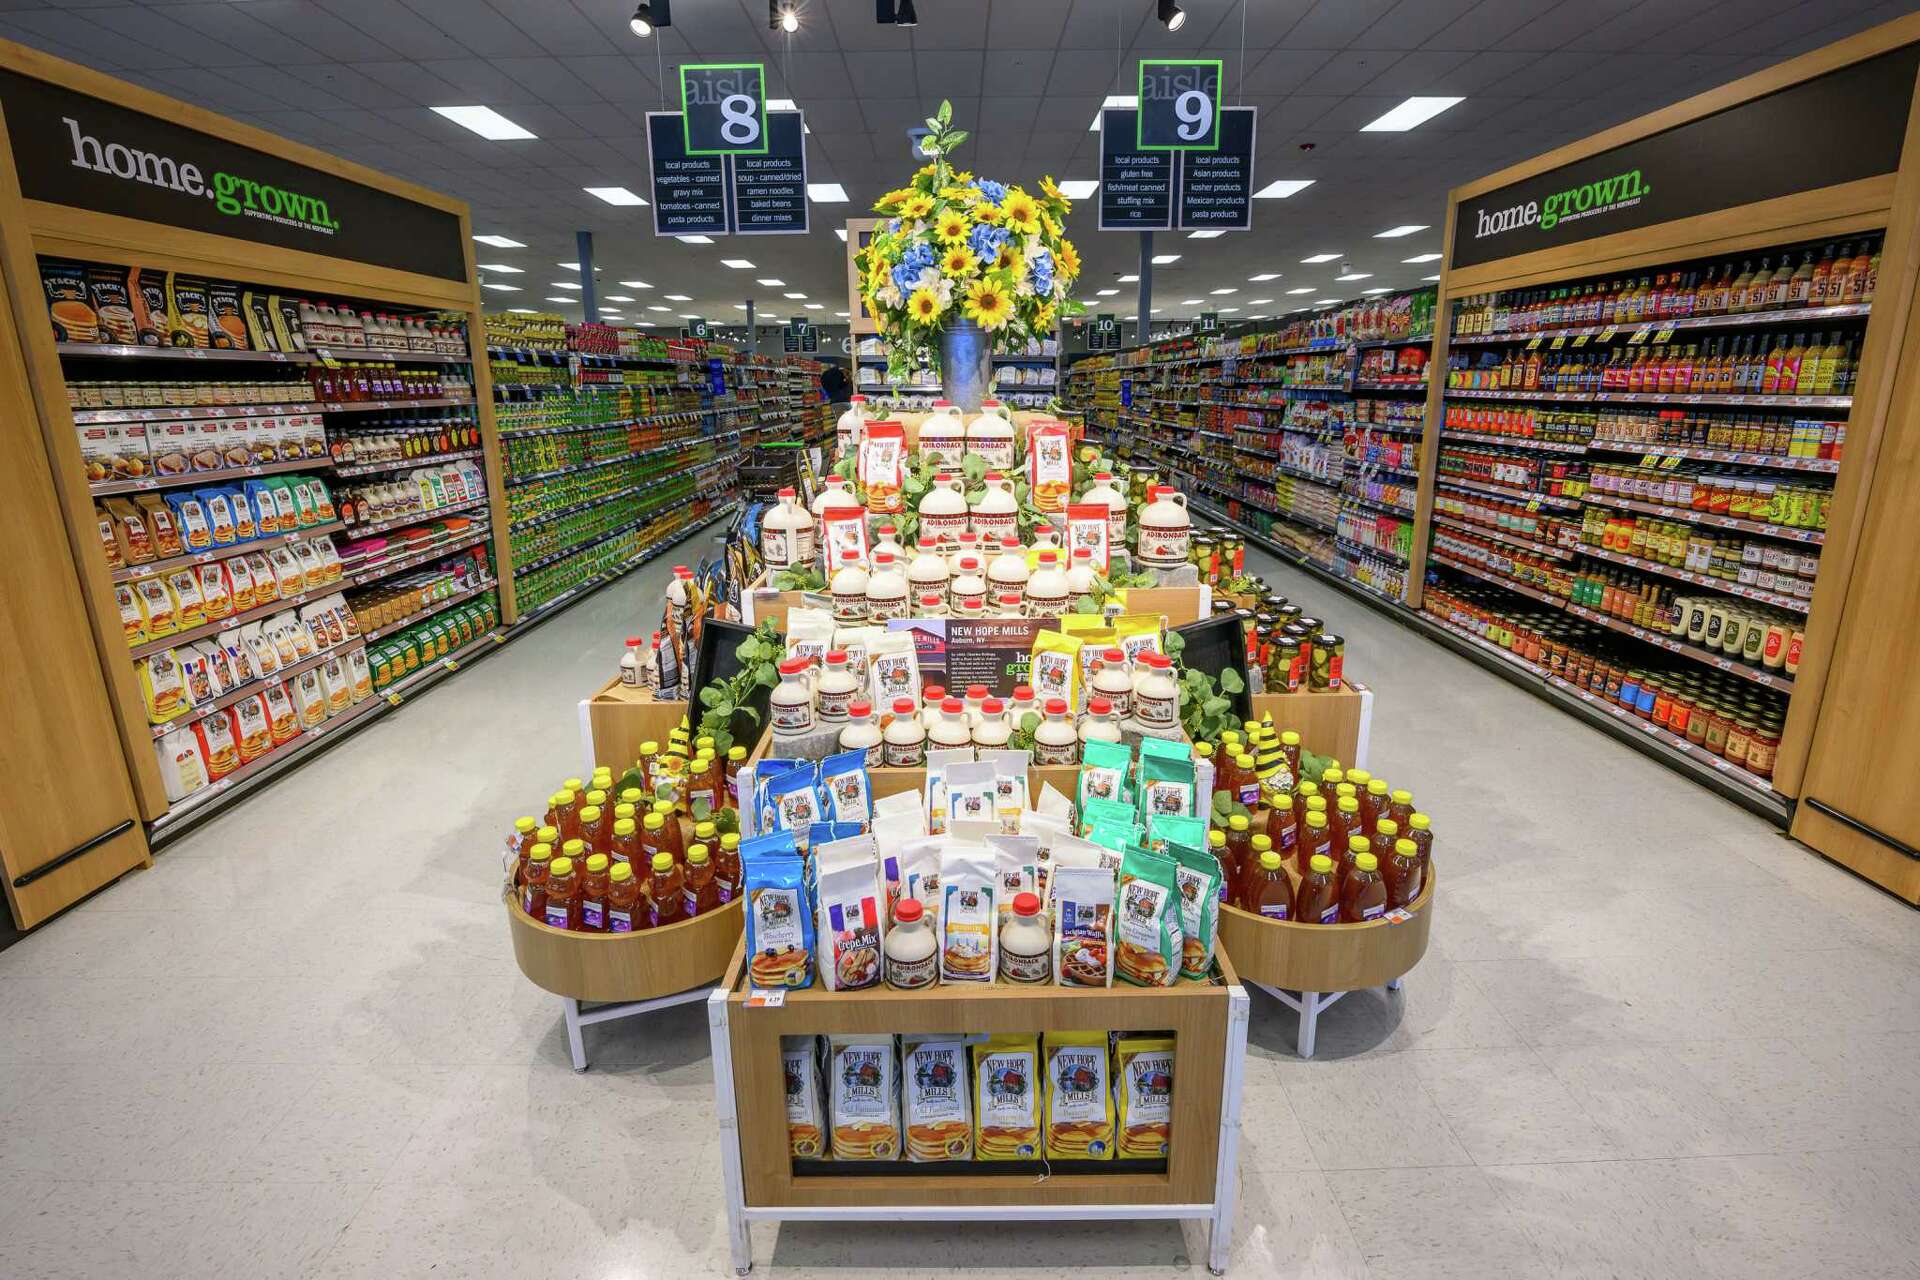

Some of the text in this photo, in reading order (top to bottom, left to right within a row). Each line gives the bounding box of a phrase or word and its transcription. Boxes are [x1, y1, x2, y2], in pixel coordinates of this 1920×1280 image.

[720, 94, 760, 144] 8
[1175, 91, 1213, 141] 9
[665, 160, 711, 170] local products
[746, 160, 792, 169] local products
[1115, 155, 1160, 165] local products
[1195, 156, 1240, 166] local products
[737, 174, 754, 183] soup
[760, 172, 802, 181] canned/dried
[1120, 170, 1153, 179] gluten free
[1192, 169, 1240, 178] Asian products
[656, 175, 690, 184] vegetables
[695, 175, 720, 183] canned
[769, 187, 795, 195] noodles
[1140, 183, 1166, 192] canned
[1191, 183, 1241, 193] kosher products
[673, 188, 704, 198] gravy mix
[660, 202, 690, 210] tomatoes
[751, 200, 792, 208] baked beans
[1117, 196, 1155, 206] stuffing mix
[1187, 196, 1245, 206] Mexican products
[668, 215, 715, 224] pasta products
[751, 213, 792, 222] dinner mixes
[1191, 210, 1239, 219] pasta products
[798, 323, 807, 334] 7
[1098, 320, 1113, 331] 10
[1203, 319, 1215, 330] 11
[696, 324, 705, 336] 6
[922, 441, 962, 449] ADIRONDACK
[968, 441, 1007, 449] ADIRONDACK
[927, 518, 968, 527] ADIRONDACK
[974, 518, 1015, 526] ADIRONDACK
[1146, 531, 1187, 539] ADIRONDACK
[951, 625, 1030, 636] NEW HOPE MILLS
[951, 637, 975, 645] Auburn,
[1127, 883, 1160, 902] NEW HOPE
[1065, 929, 1104, 939] Belgian Waffle
[838, 934, 877, 952] Crepe Mix
[896, 958, 933, 969] ADIRONDACK
[843, 1051, 883, 1069] NEW HOPE
[914, 1049, 954, 1068] NEW HOPE
[1057, 1054, 1098, 1073] NEW HOPE
[986, 1058, 1027, 1077] NEW HOPE
[1132, 1060, 1151, 1079] NEW
[851, 1087, 875, 1096] MILLS
[925, 1087, 948, 1096] MILLS
[996, 1095, 1019, 1104] MILLS
[1067, 1093, 1090, 1101] MILLS
[1144, 1095, 1167, 1104] MILLS
